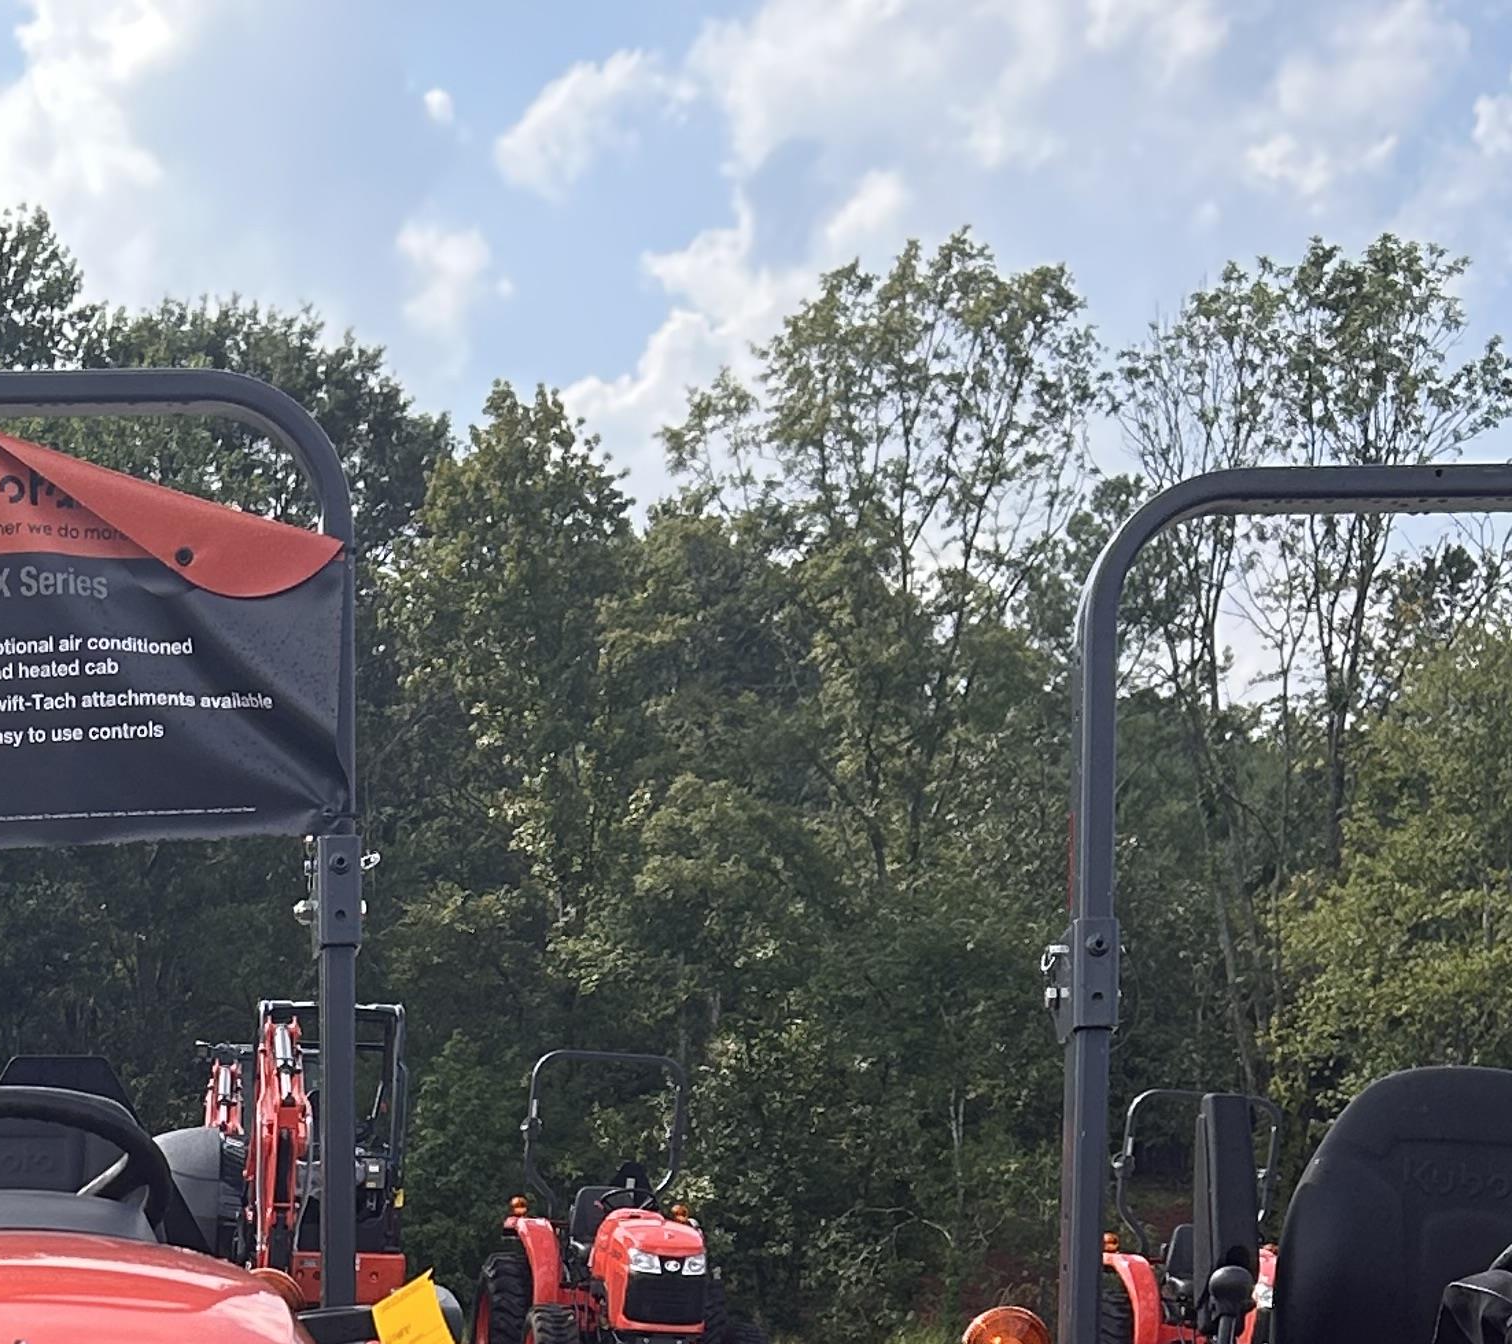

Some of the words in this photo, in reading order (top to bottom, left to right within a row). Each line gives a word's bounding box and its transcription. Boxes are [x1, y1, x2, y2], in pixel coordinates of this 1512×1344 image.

[28, 523, 53, 536] we
[58, 523, 79, 539] do
[19, 565, 109, 600] Series
[58, 634, 83, 653] air
[87, 636, 193, 656] conditioned
[18, 658, 80, 679] heated
[84, 657, 119, 676] cab
[81, 689, 196, 709] attachments
[199, 691, 274, 711] available
[27, 726, 47, 743] to
[51, 726, 83, 742] use
[88, 720, 165, 740] controls
